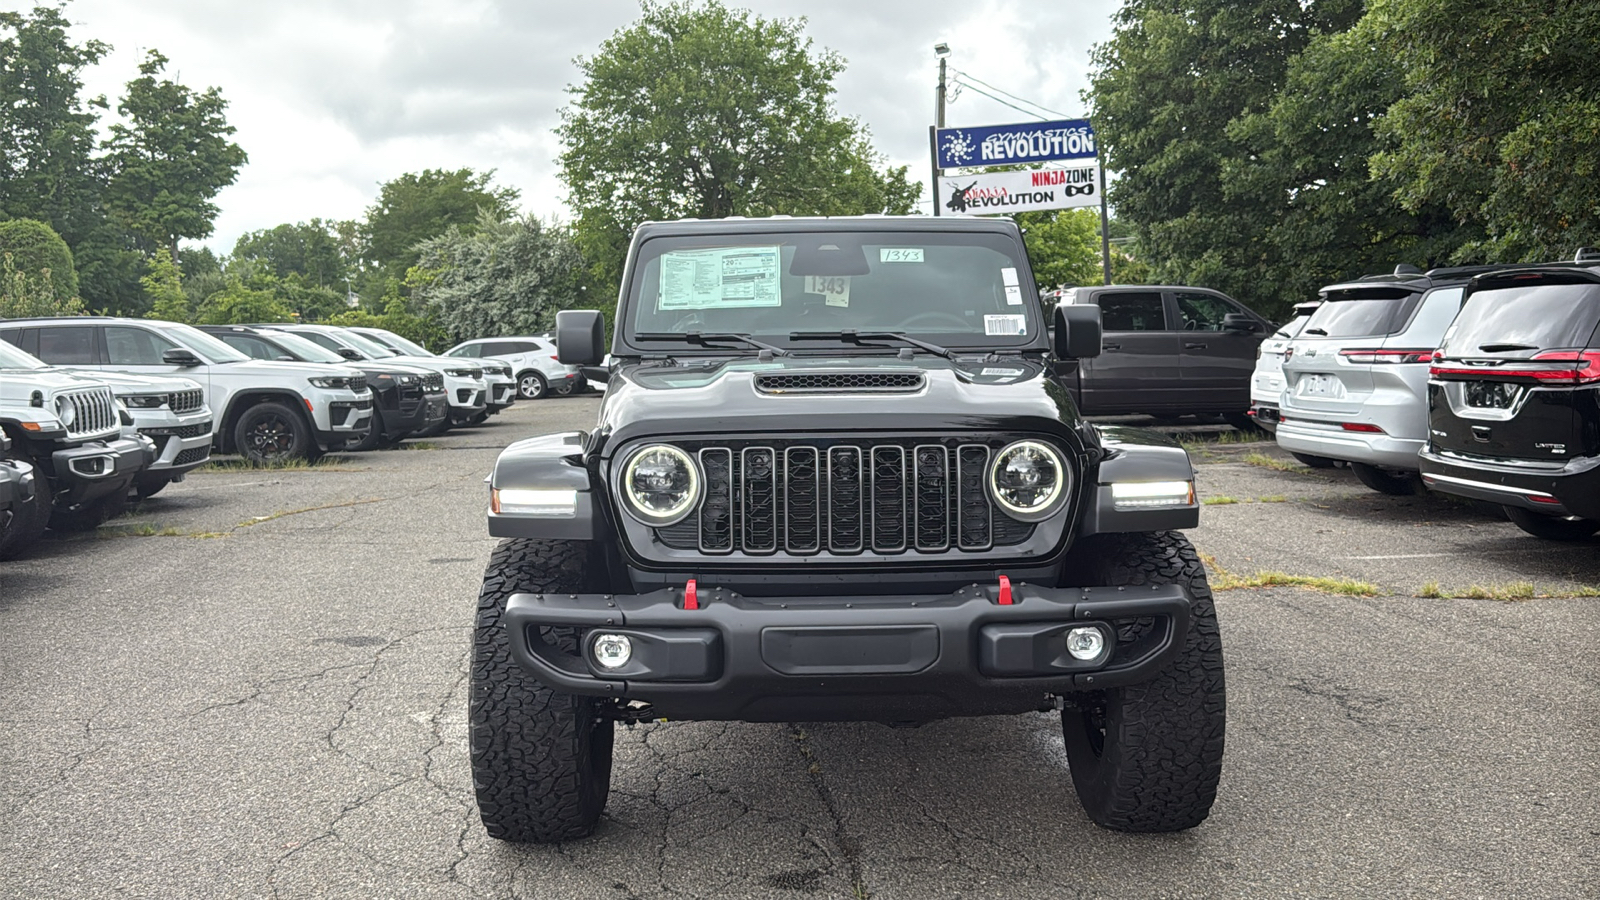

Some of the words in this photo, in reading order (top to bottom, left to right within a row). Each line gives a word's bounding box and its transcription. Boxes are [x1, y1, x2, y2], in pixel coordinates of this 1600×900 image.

[985, 127, 1088, 144] GYMNASTICS
[981, 133, 1095, 161] REVOLUTION
[964, 191, 1054, 208] REVOLUTION
[885, 249, 921, 261] 1343
[811, 275, 845, 295] 1343
